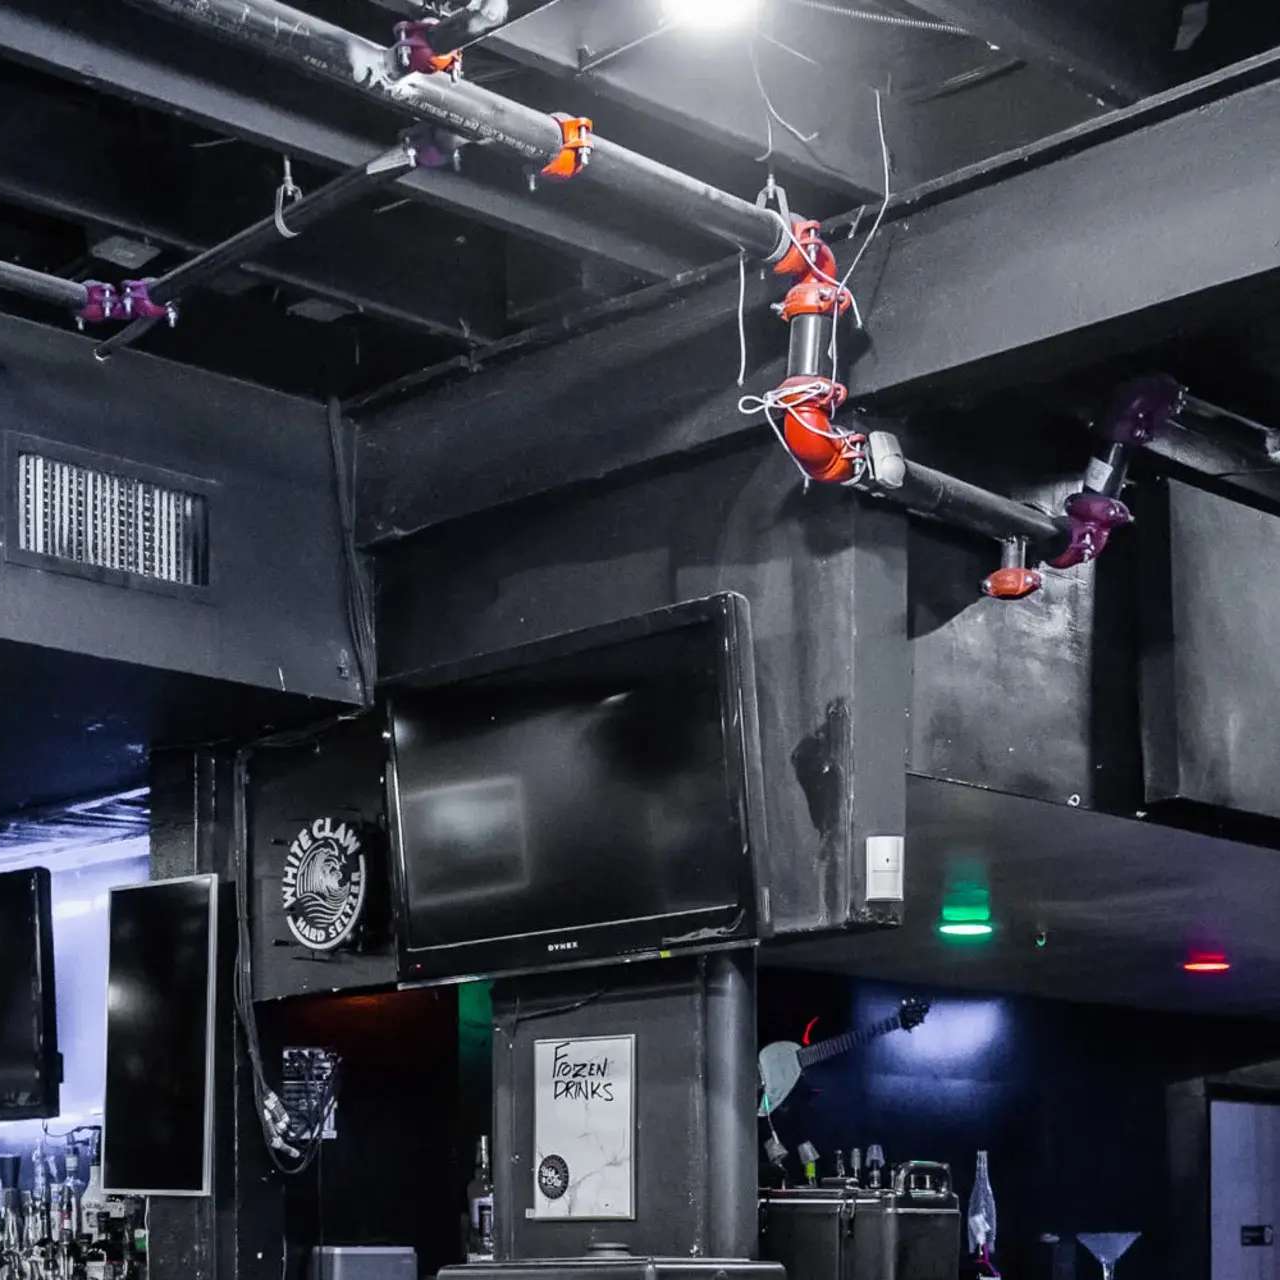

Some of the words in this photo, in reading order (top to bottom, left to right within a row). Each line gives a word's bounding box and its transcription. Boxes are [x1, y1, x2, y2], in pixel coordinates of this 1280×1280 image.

[282, 828, 312, 908] WHITE
[312, 817, 361, 855] CLAW
[296, 916, 326, 942] HARD
[547, 941, 578, 952] DYNEX
[554, 1079, 614, 1102] DRINKS
